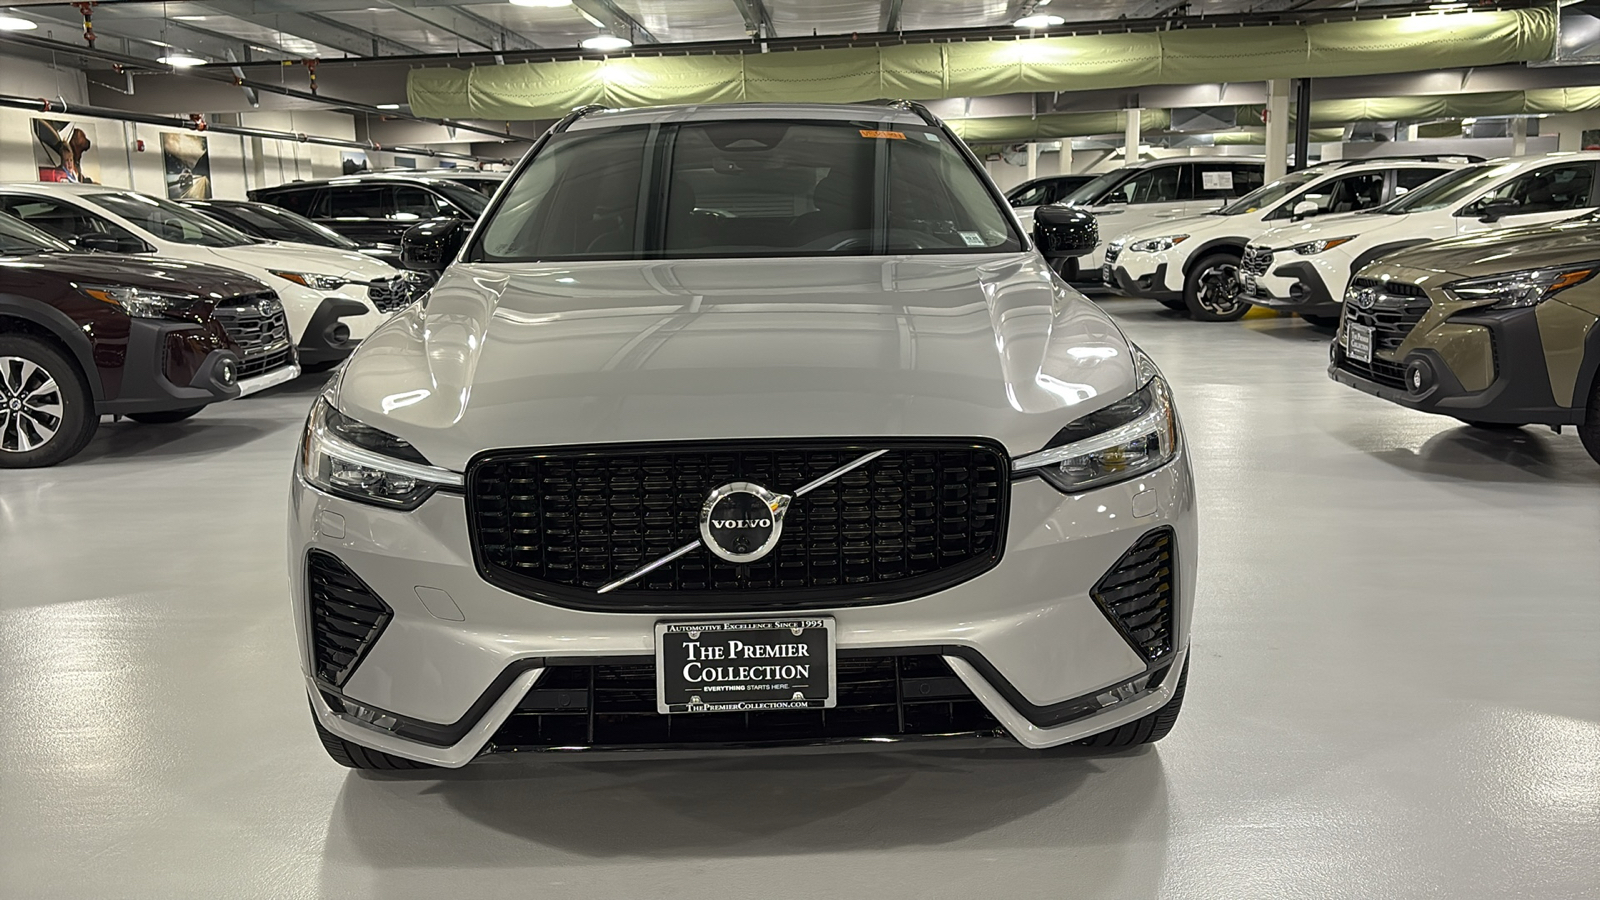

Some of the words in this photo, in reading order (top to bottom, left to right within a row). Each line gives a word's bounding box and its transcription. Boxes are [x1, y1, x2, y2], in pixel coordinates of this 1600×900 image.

[711, 519, 771, 529] VOLVO
[802, 620, 823, 628] 1995
[682, 641, 725, 661] THE
[728, 640, 810, 660] PREMIER
[682, 662, 810, 683] COLLECTION
